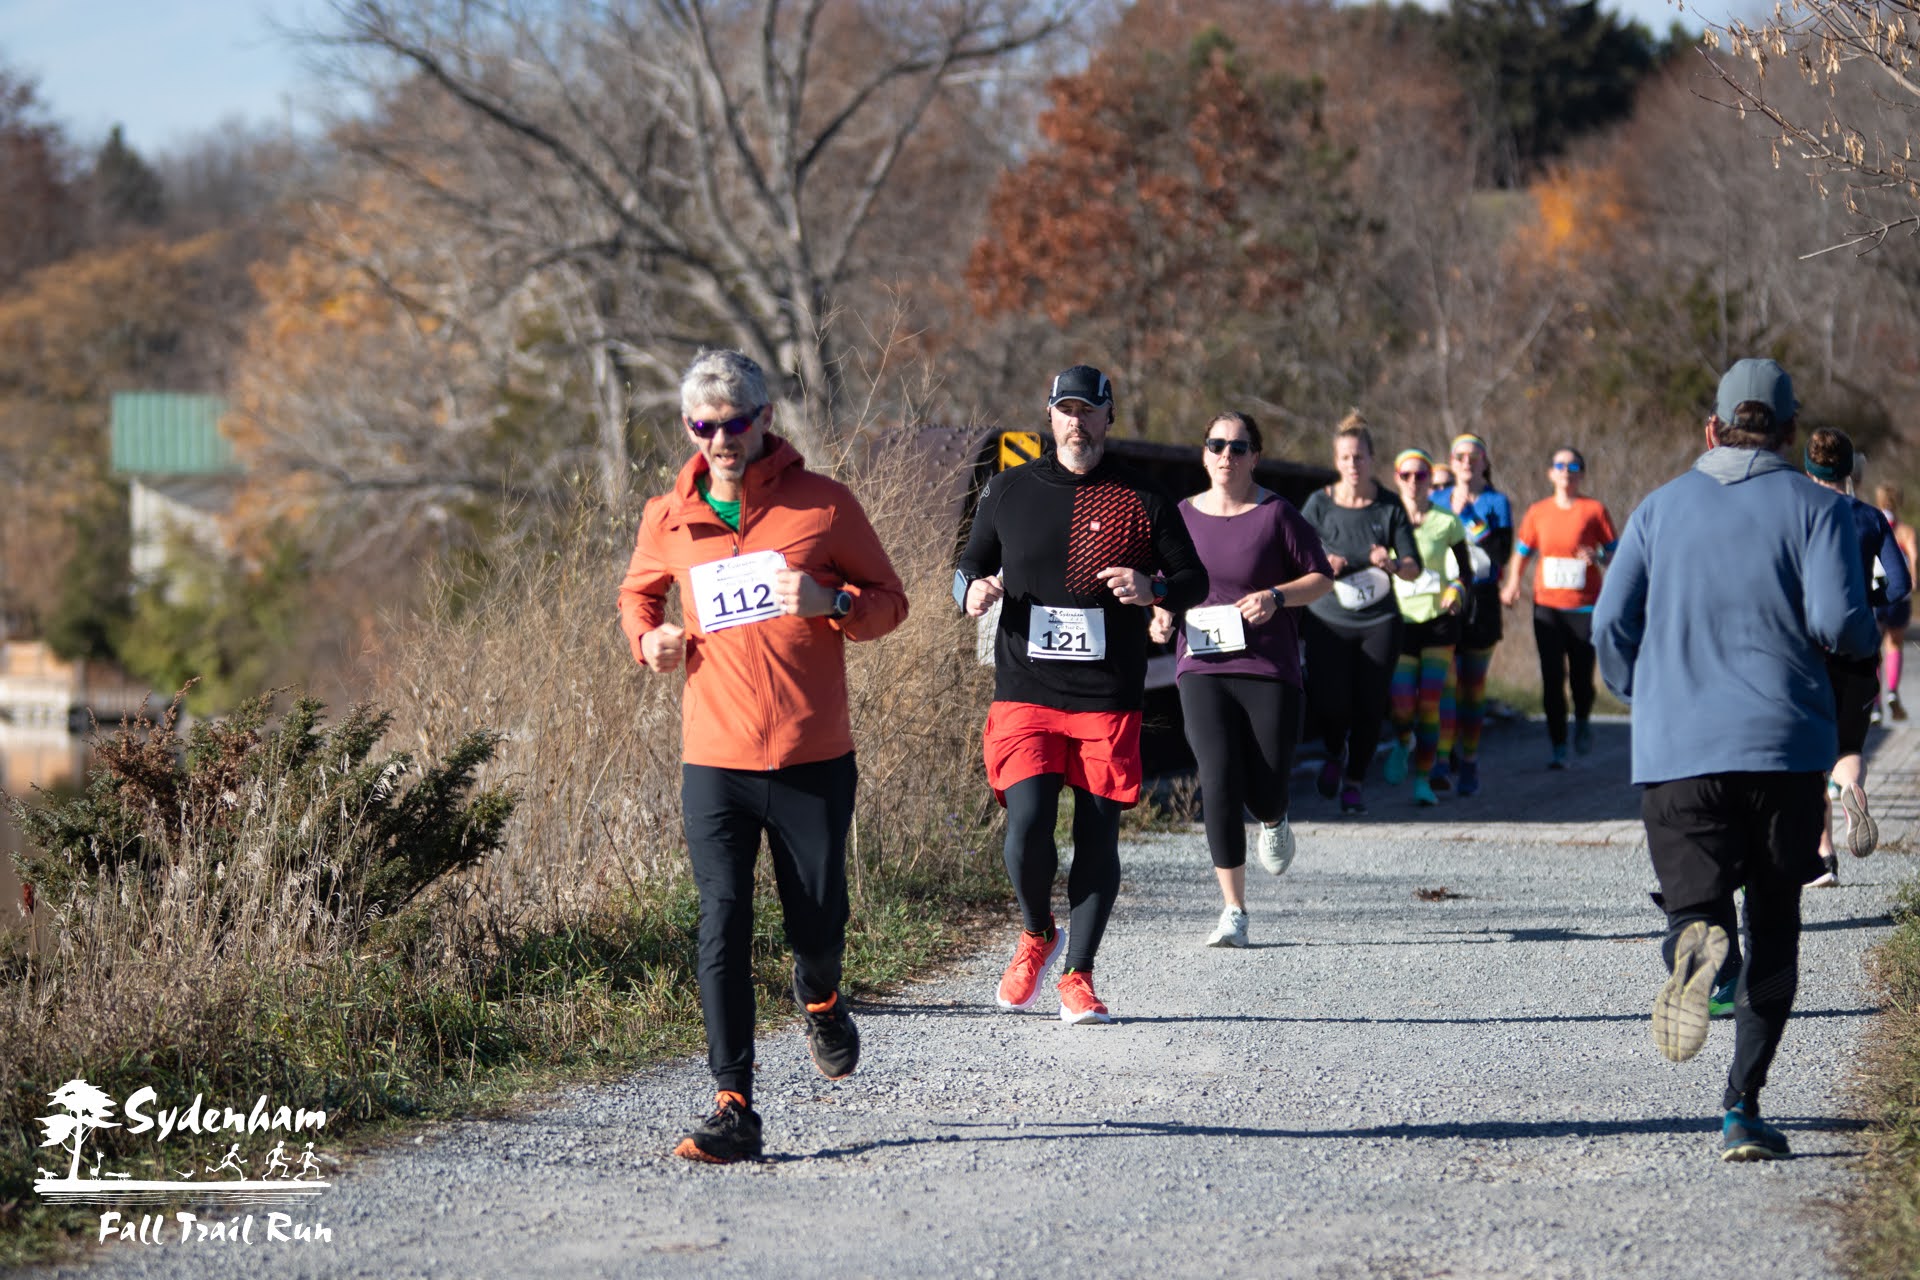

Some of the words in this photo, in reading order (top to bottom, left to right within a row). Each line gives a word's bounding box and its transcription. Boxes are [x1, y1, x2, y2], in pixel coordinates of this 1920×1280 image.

[712, 583, 775, 618] 112
[1041, 630, 1092, 653] 121
[1201, 627, 1226, 646] 71
